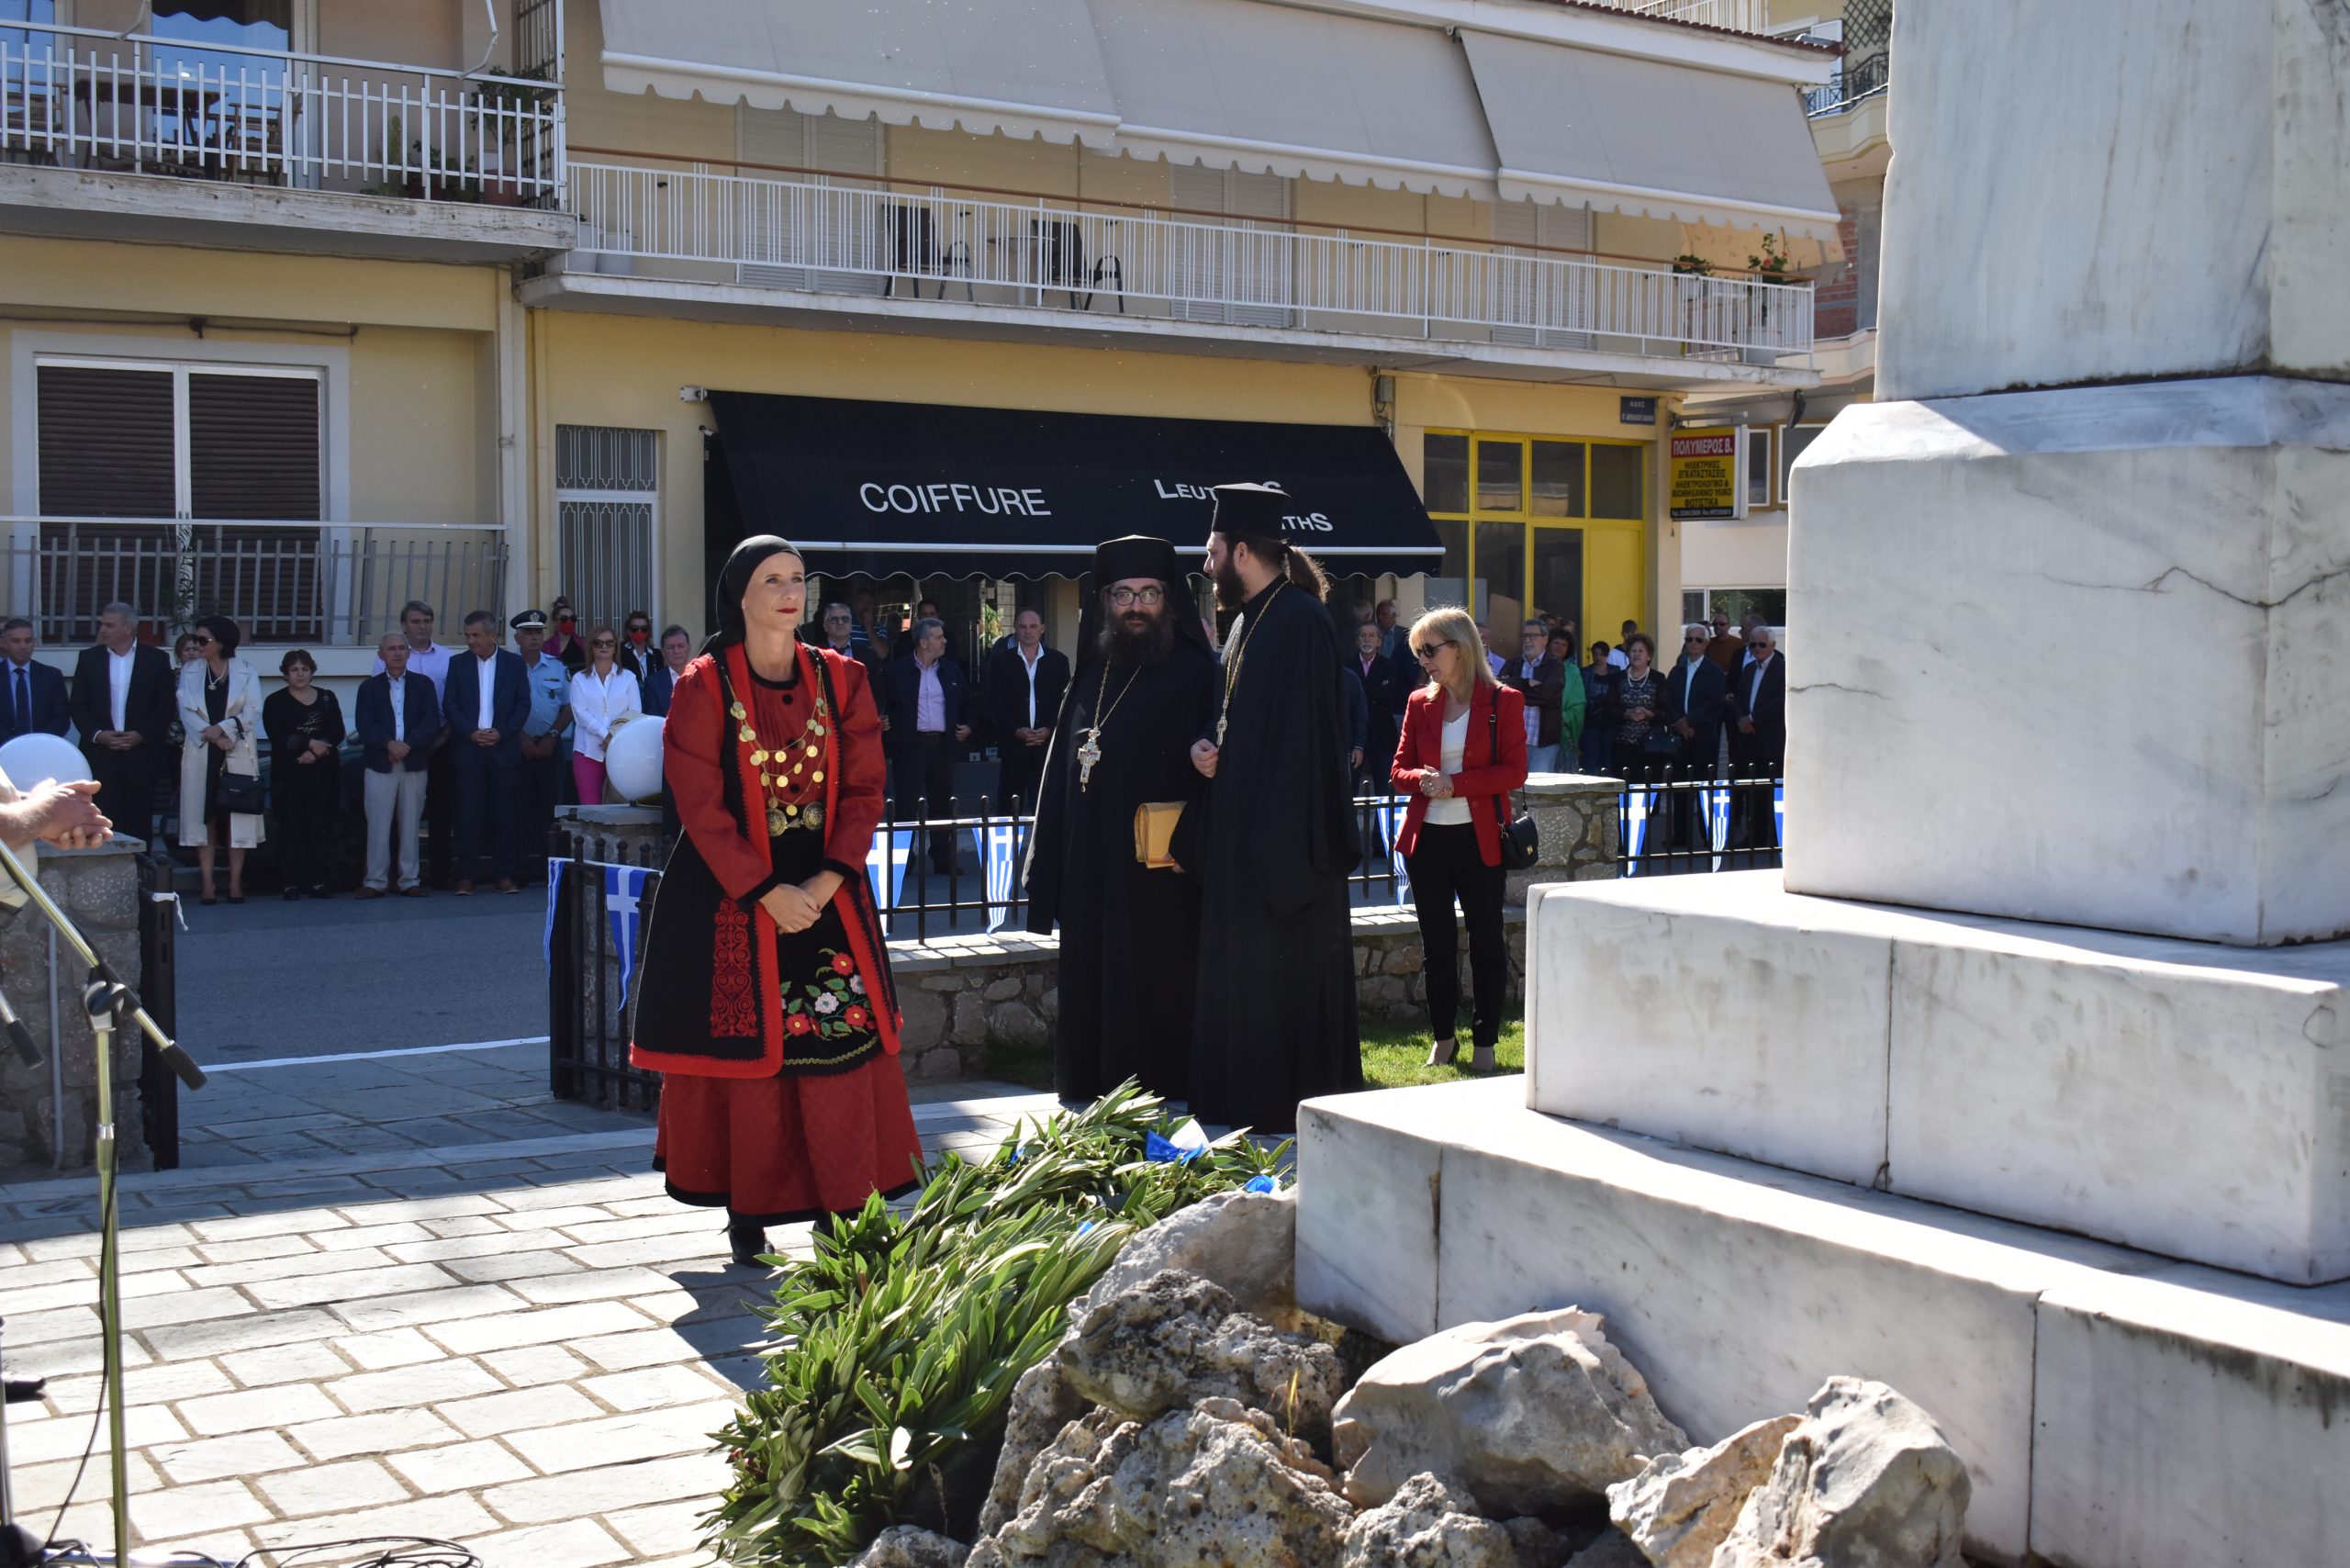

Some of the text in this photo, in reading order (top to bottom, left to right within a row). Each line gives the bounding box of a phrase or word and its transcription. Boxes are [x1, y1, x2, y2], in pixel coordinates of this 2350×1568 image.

[1673, 438, 1732, 455] ΠΟΛΥΜΕΡΟΣ Β.
[1678, 468, 1726, 478] ΕΓΚΑΤΑΣΤΑΣΕΙΣ
[1684, 460, 1719, 469] ΗΛΕΚΤΡΙΚΕΣ
[859, 483, 1052, 516] COIFFURE
[1281, 512, 1334, 532] THS
